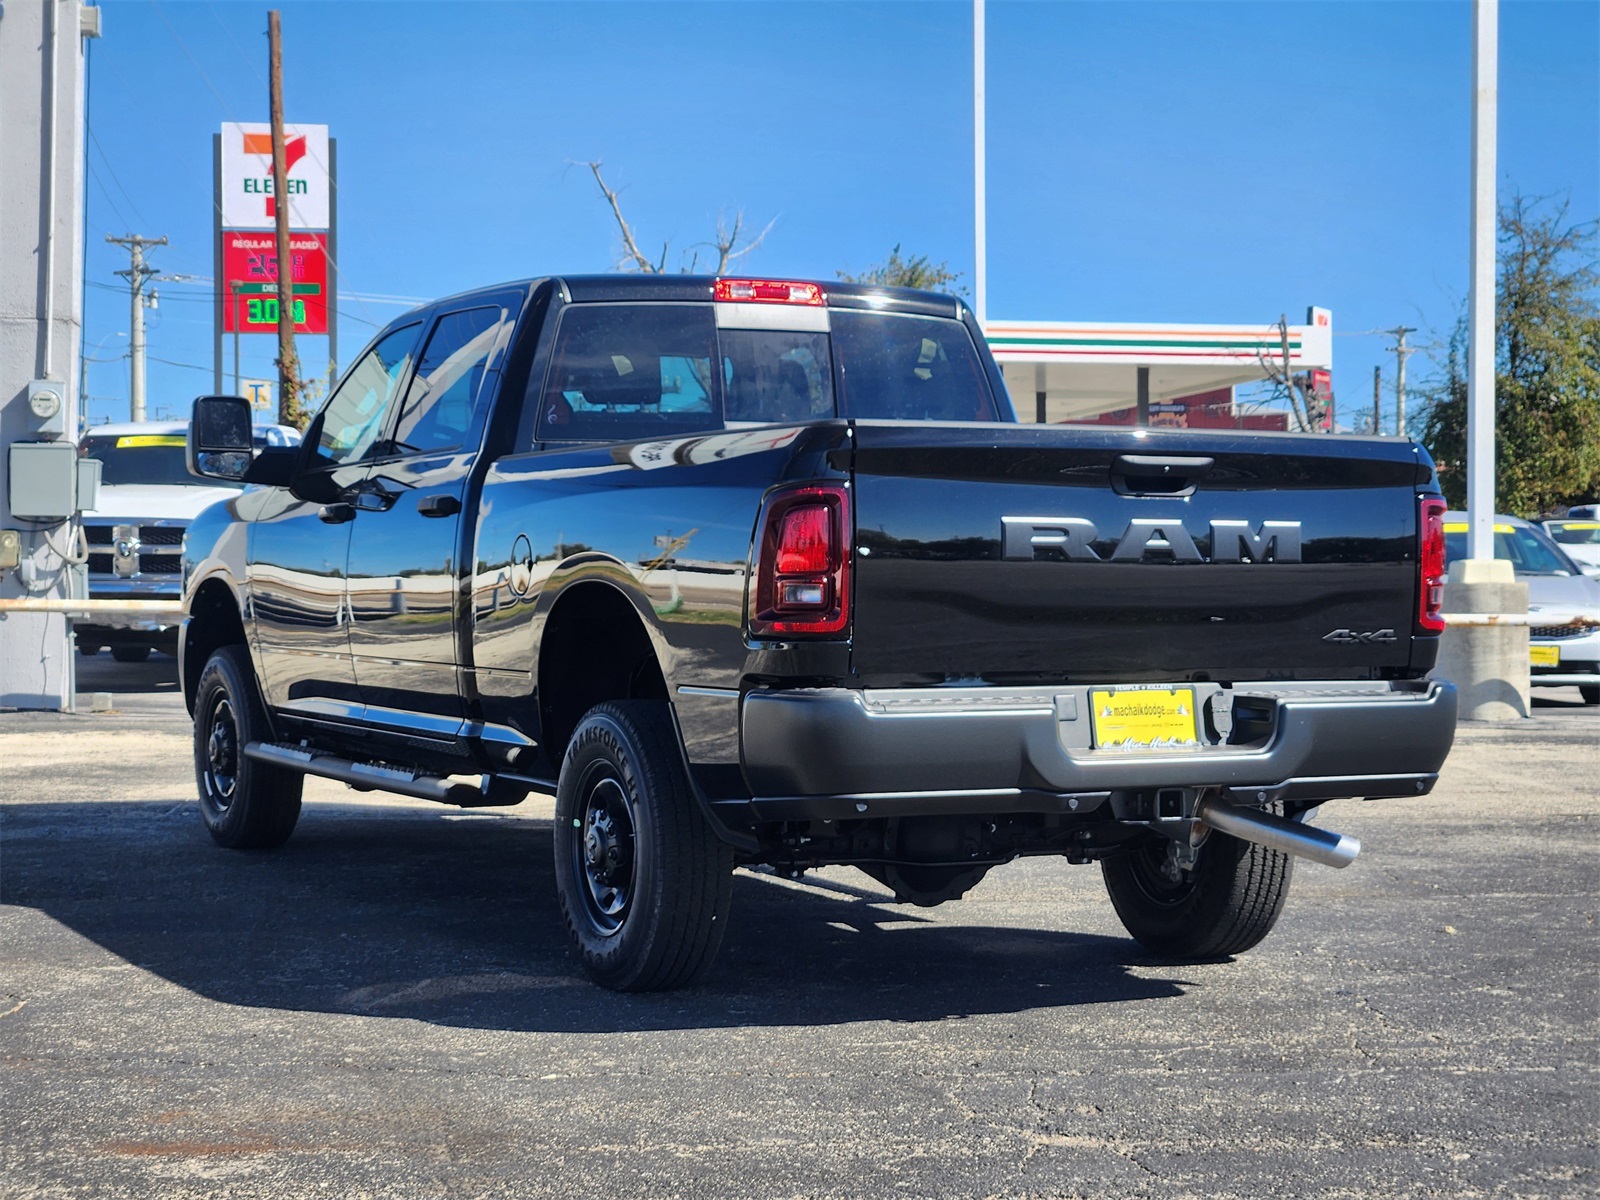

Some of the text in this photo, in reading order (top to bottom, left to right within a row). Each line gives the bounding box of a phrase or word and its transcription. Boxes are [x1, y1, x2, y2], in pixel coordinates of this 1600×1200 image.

[232, 239, 273, 249] REGULAR
[1000, 515, 1302, 564] RAM
[1321, 628, 1398, 645] 4x4
[567, 726, 629, 769] TRANSFORCE
